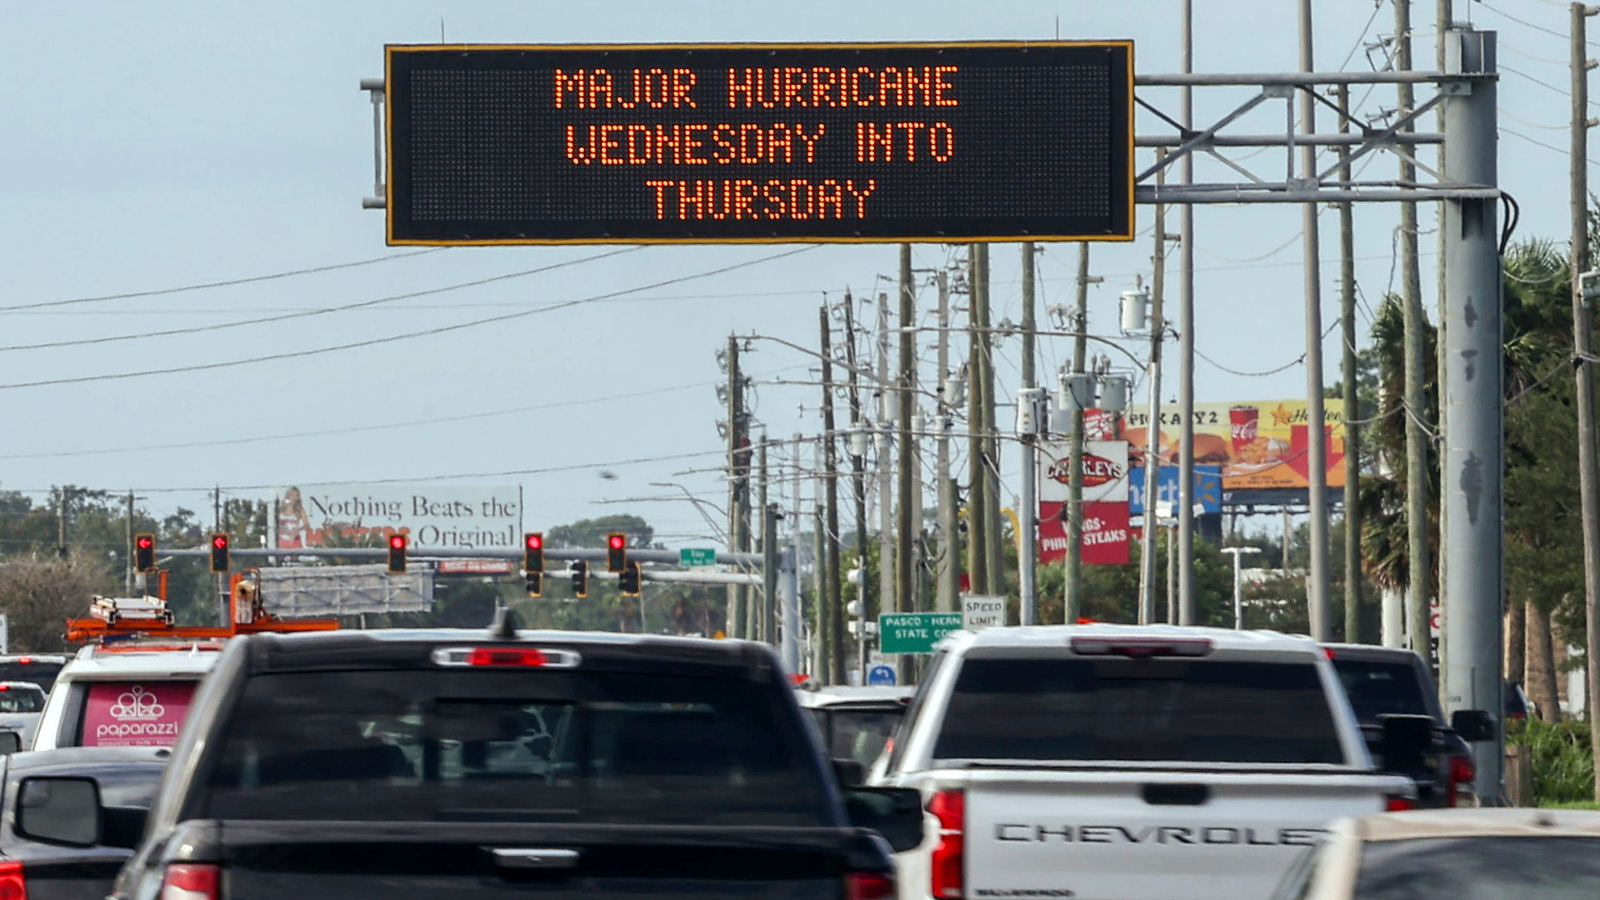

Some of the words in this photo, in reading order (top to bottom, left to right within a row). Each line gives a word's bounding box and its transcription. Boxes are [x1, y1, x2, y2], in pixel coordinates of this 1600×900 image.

[554, 67, 696, 109] MAJOR
[728, 65, 959, 108] HURRICANE
[566, 122, 826, 165] WEDNESDAY
[856, 121, 954, 162] INTO
[645, 178, 876, 221] THURSDAY
[1130, 412, 1167, 425] PIK
[1170, 411, 1206, 425] AY
[1209, 411, 1218, 424] 2
[1046, 460, 1124, 479] CHRLEYS
[309, 496, 403, 521] Nothing
[412, 495, 473, 517] Beats
[482, 497, 516, 517] the
[418, 525, 514, 549] Original
[1042, 538, 1069, 551] PHIL
[1083, 529, 1127, 546] STEAKS
[966, 603, 1002, 612] SPEED
[886, 617, 922, 626] PASCO
[931, 617, 961, 625] HERN
[970, 616, 997, 625] LIMIT
[895, 629, 928, 639] STATE
[934, 630, 947, 639] CO
[97, 721, 178, 737] paparazzi
[994, 822, 1336, 847] CHEVROLE
